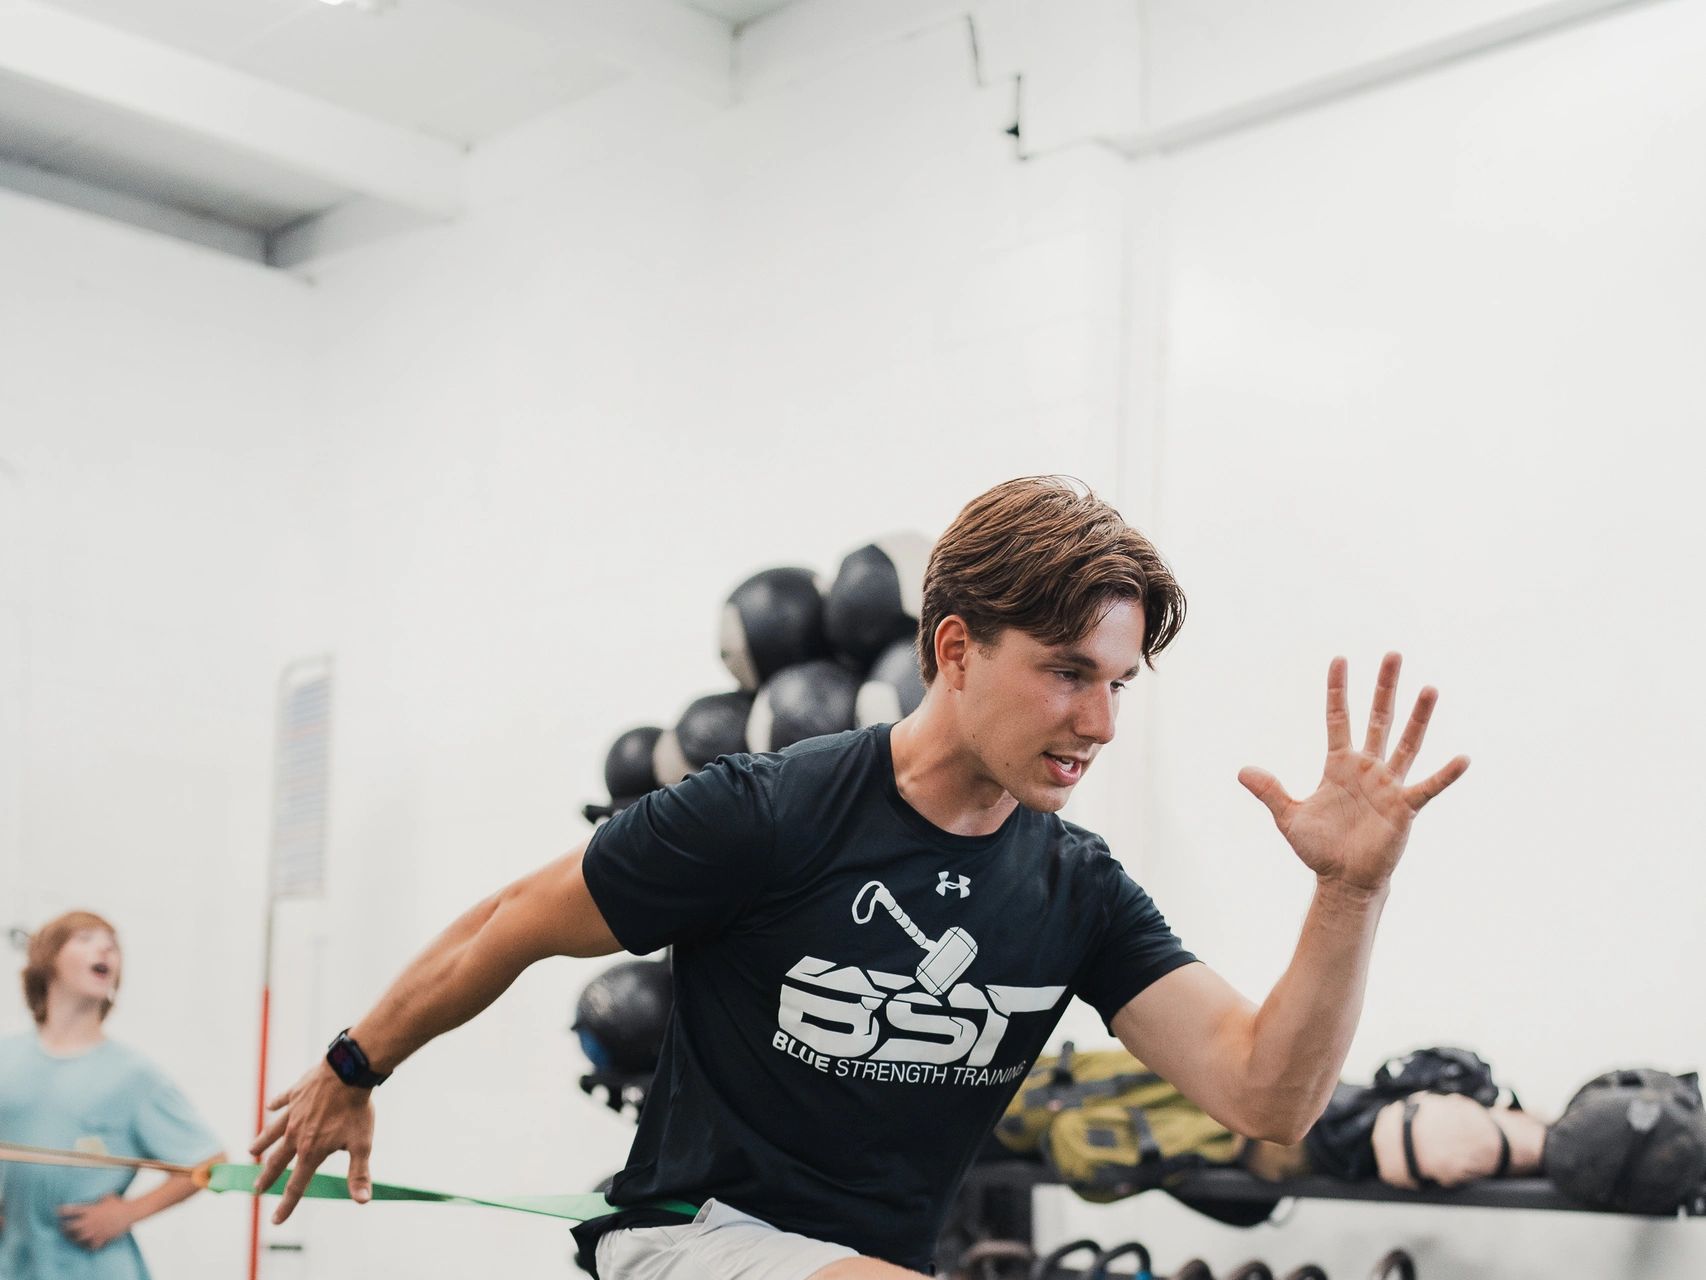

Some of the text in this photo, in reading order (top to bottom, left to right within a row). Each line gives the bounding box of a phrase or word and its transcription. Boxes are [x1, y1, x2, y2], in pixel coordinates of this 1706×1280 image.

[777, 956, 1067, 1067] BST
[772, 1031, 1027, 1086] BLUE STRENGTH TRAINING
